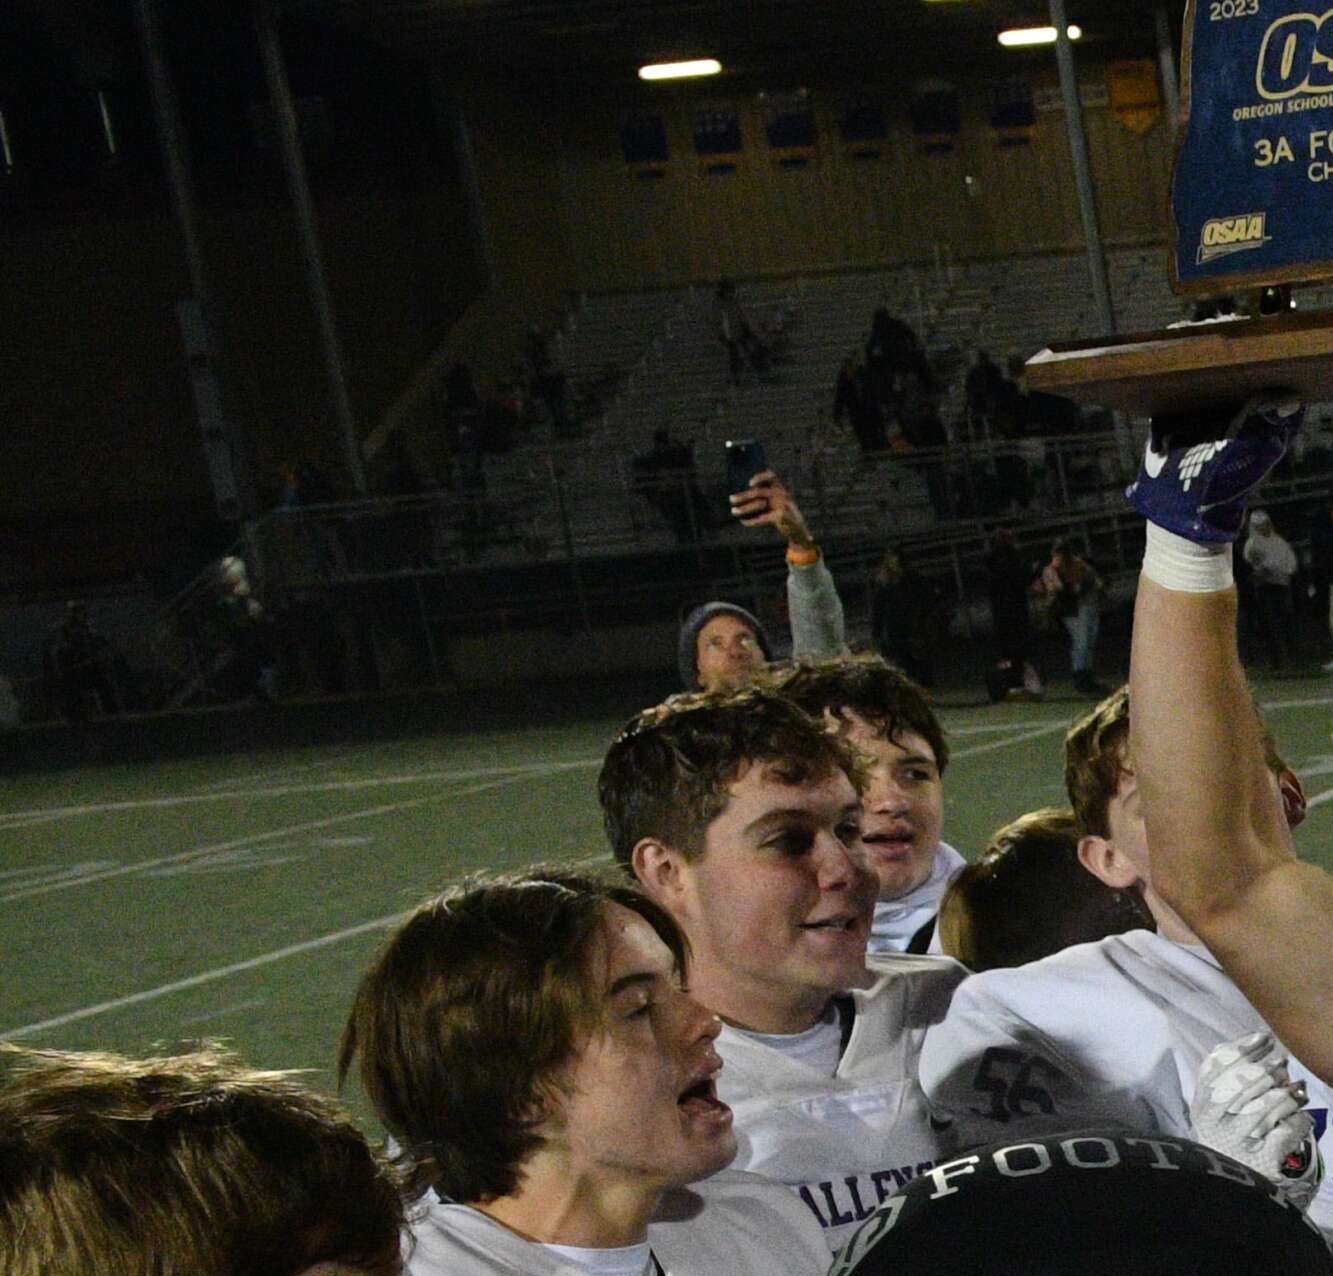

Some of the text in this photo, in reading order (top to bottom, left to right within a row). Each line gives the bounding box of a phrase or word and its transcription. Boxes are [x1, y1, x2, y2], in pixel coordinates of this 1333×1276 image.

[1209, 0, 1260, 21] 2023
[1232, 102, 1284, 121] OREGON
[1254, 136, 1295, 167] 3A
[1202, 213, 1264, 246] OSAA
[924, 1136, 1289, 1209] FOOTB
